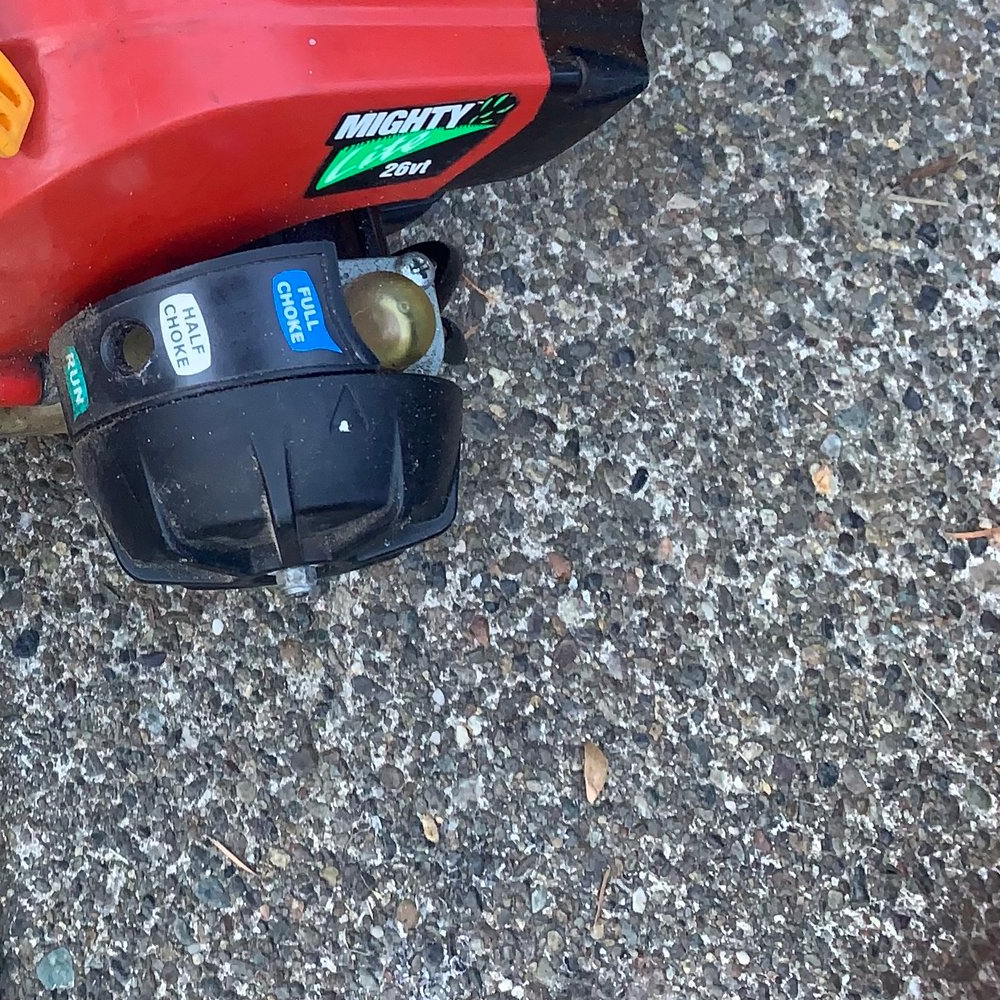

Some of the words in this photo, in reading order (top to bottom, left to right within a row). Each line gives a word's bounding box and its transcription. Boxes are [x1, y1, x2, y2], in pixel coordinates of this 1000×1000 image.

[333, 102, 475, 141] MIGHTY
[323, 131, 432, 185] Lite
[378, 158, 433, 179] 26vt
[181, 305, 206, 356] HALF
[275, 280, 306, 345] CHOKE
[297, 285, 314, 333] FULL
[163, 303, 191, 370] CHOKE
[65, 352, 85, 405] RUN
